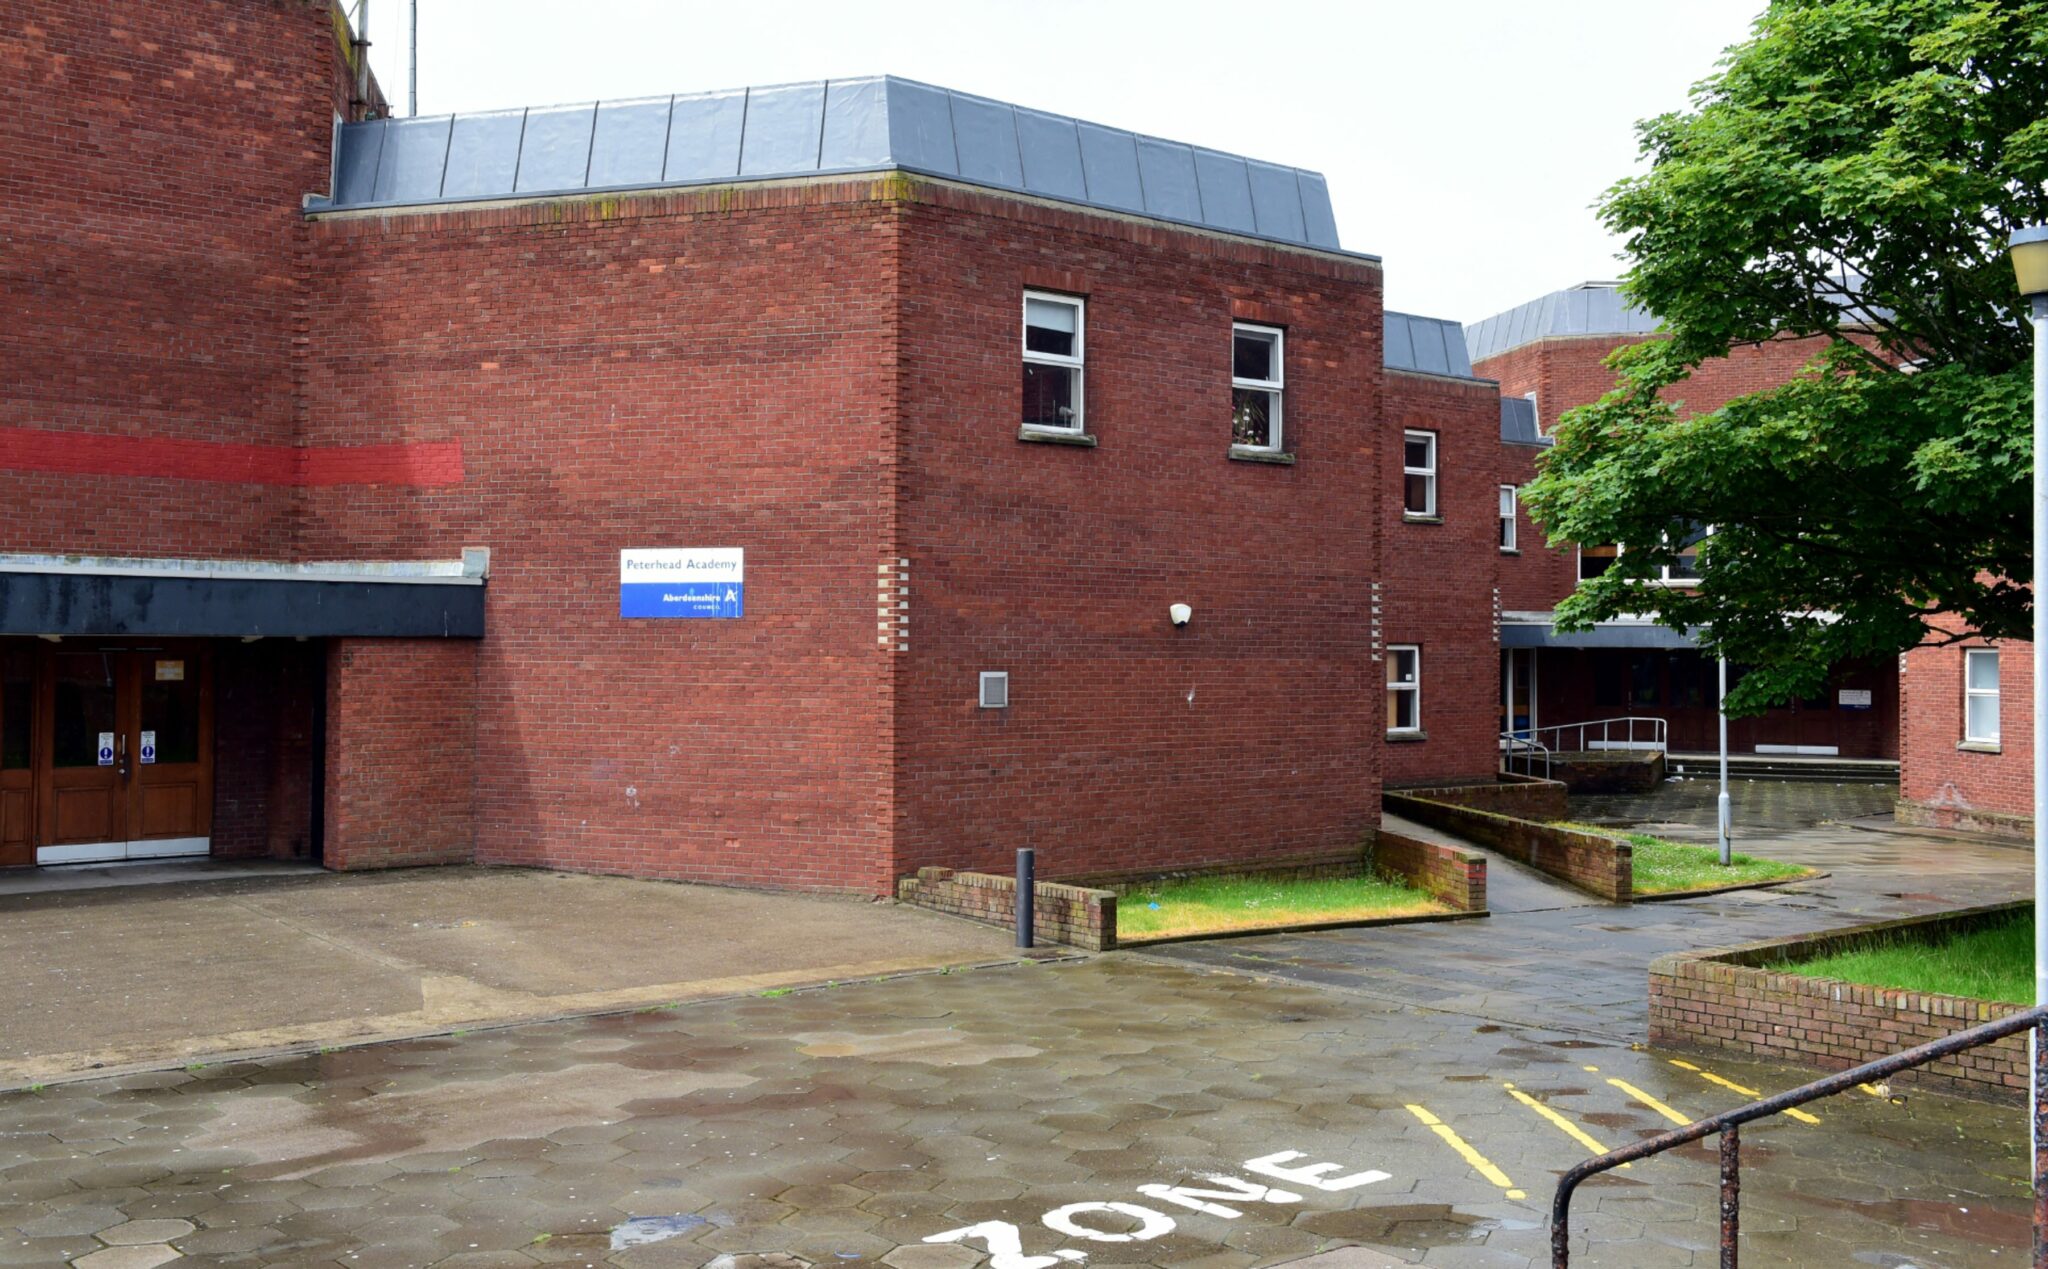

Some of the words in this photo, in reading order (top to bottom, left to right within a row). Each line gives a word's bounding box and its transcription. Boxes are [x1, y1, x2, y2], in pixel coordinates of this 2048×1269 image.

[626, 559, 682, 570] Peterhead
[686, 559, 737, 572] Academy
[662, 593, 721, 602] Aberdeenshire
[922, 1150, 1393, 1269] ZONE
